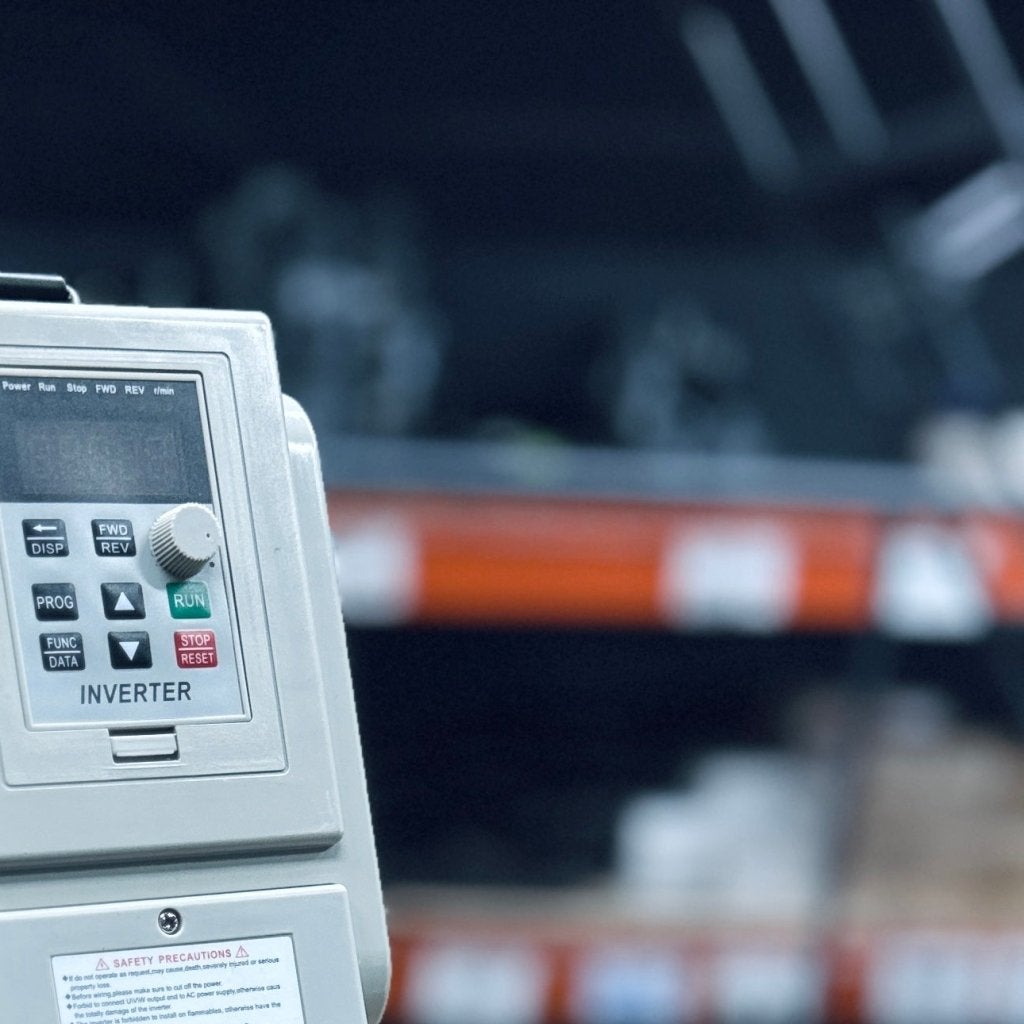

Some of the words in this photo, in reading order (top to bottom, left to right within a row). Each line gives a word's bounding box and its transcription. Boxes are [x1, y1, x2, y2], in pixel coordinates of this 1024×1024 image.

[2, 381, 31, 391] Power
[38, 382, 56, 392] Run
[67, 383, 87, 394] Stop
[96, 384, 117, 394] FWD
[125, 385, 145, 394] REV
[154, 386, 174, 396] r/min
[99, 524, 128, 535] FWD
[31, 543, 64, 555] DISP
[101, 542, 129, 553] REV
[36, 595, 74, 609] PROG
[175, 594, 205, 607] RUN
[46, 637, 77, 648] FUNC
[181, 634, 210, 646] STOP
[49, 655, 79, 668] DATA
[181, 652, 214, 664] RESET
[80, 681, 192, 705] INVERTER
[113, 956, 153, 967] SAFETY
[158, 949, 231, 963] PRECAUTIONS
[95, 972, 117, 980] operate
